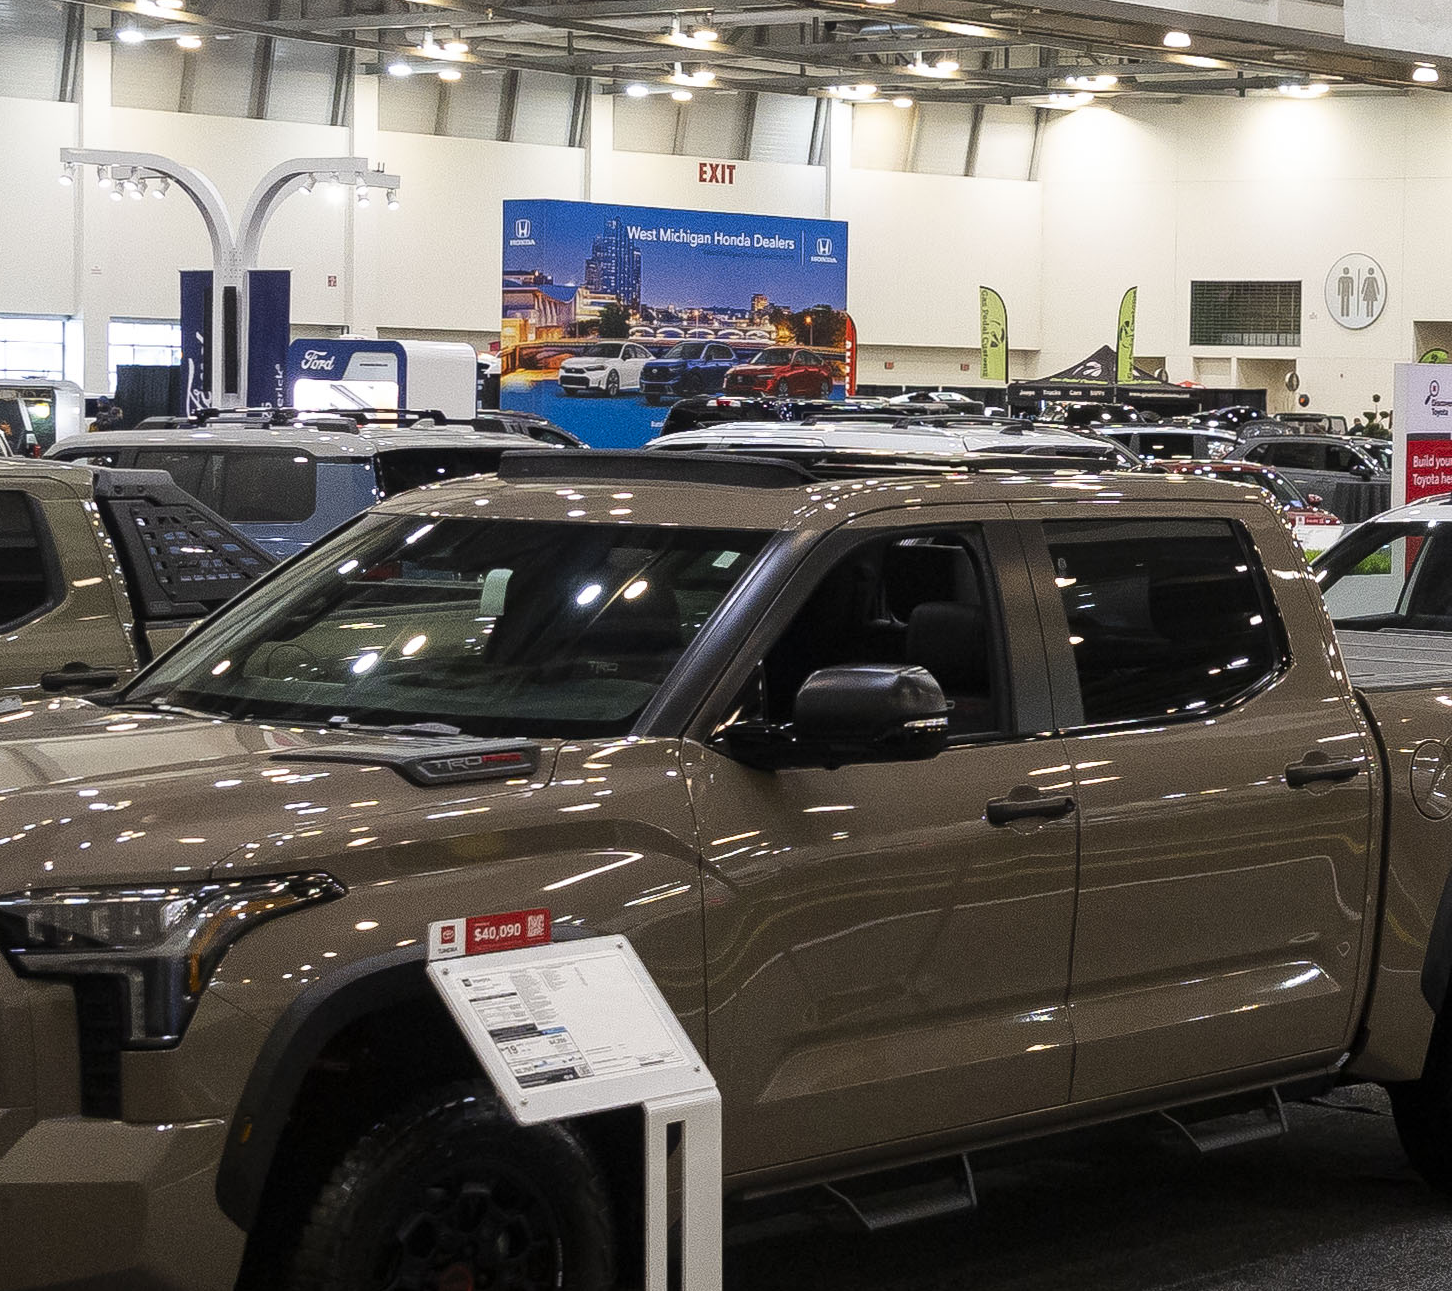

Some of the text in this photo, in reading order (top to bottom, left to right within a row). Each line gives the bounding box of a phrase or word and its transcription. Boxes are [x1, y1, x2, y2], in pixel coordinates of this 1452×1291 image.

[698, 162, 736, 185] EXIT
[627, 226, 795, 250] West Michigan Honda Dealers
[301, 349, 336, 371] Ford
[1412, 453, 1435, 468] Build
[1412, 473, 1440, 489] Toyota
[474, 923, 522, 942] $40,090
